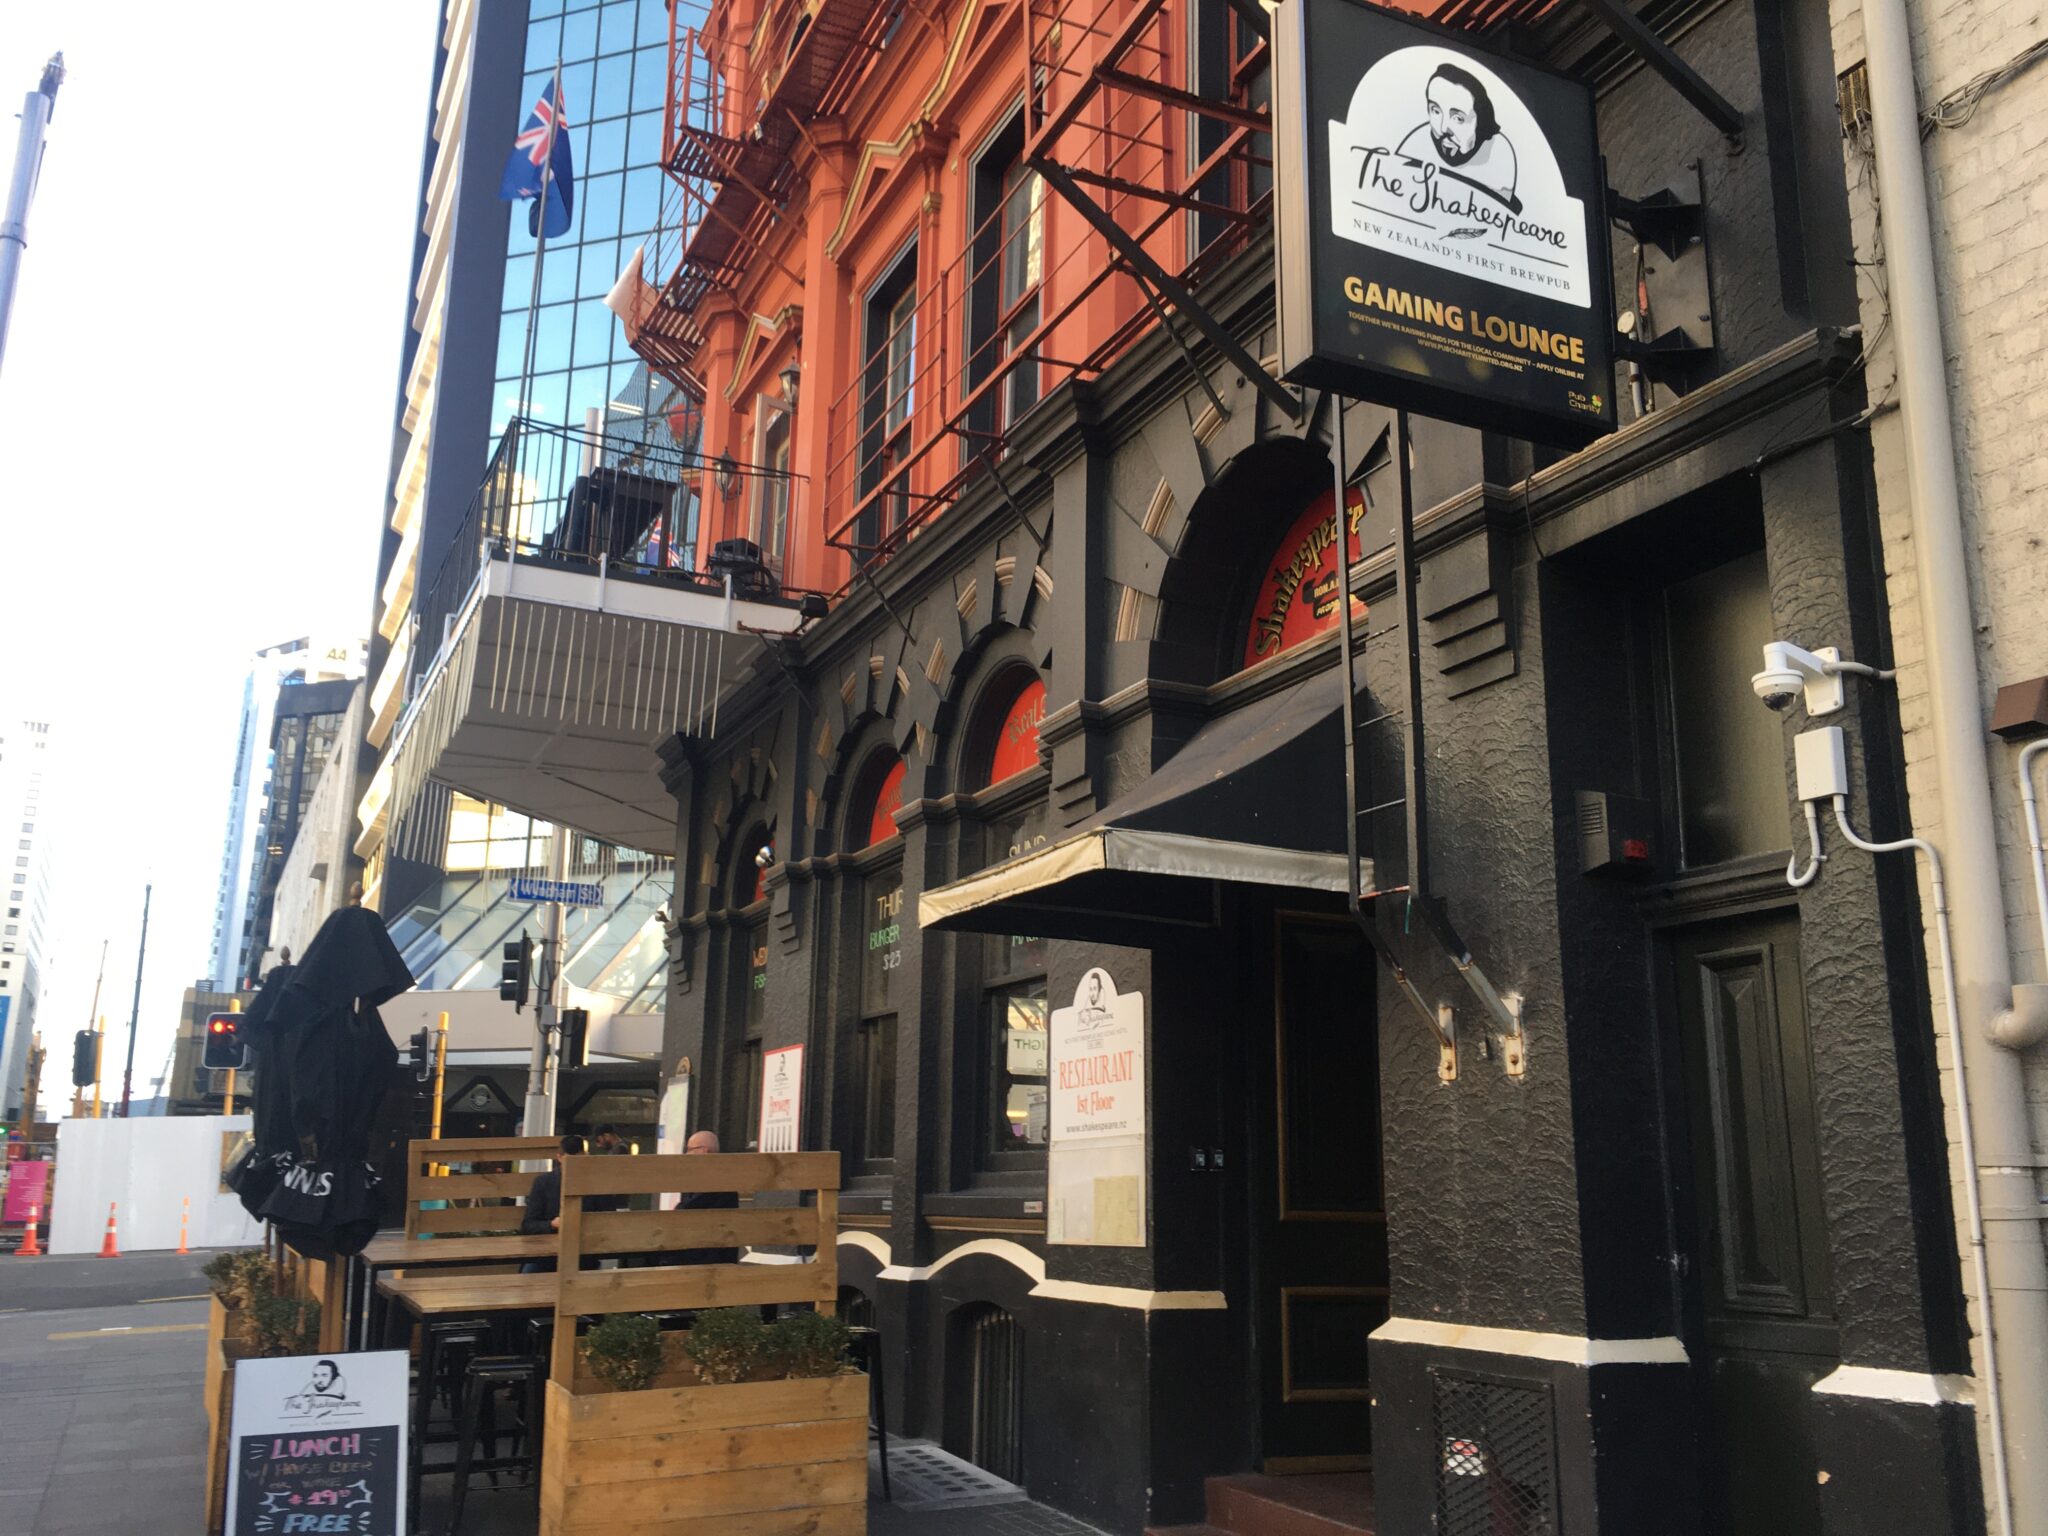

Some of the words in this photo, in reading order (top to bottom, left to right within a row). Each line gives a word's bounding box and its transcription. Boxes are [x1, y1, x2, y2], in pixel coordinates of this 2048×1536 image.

[1350, 146, 1404, 197] The
[1409, 162, 1567, 249] Shakespeare
[1353, 218, 1382, 235] NEW
[1387, 229, 1462, 260] ZEALAND'S
[1467, 253, 1505, 273] FIRST
[1510, 265, 1571, 290] BREWPUB
[1344, 276, 1464, 332] GAMING
[1470, 310, 1585, 365] LOUNGE
[1347, 311, 1381, 326] TOGETHER
[1401, 326, 1426, 338] RAISING
[1427, 333, 1447, 344] FUNDS
[1447, 338, 1460, 347] FOR
[1460, 341, 1472, 351] THE
[1472, 345, 1493, 357] LOCAL
[1492, 350, 1532, 367] COMMUNITY
[1536, 362, 1554, 373] APPLY
[1554, 366, 1576, 378] ONLINE
[1567, 390, 1586, 402] Pub
[1568, 399, 1601, 415] Charity
[580, 886, 592, 900] St
[869, 924, 900, 950] BURGER
[1058, 1050, 1134, 1090] RESTAURANT
[1090, 1090, 1115, 1116] Floor
[270, 1433, 361, 1459] LUNCH
[282, 1513, 353, 1533] FREE
